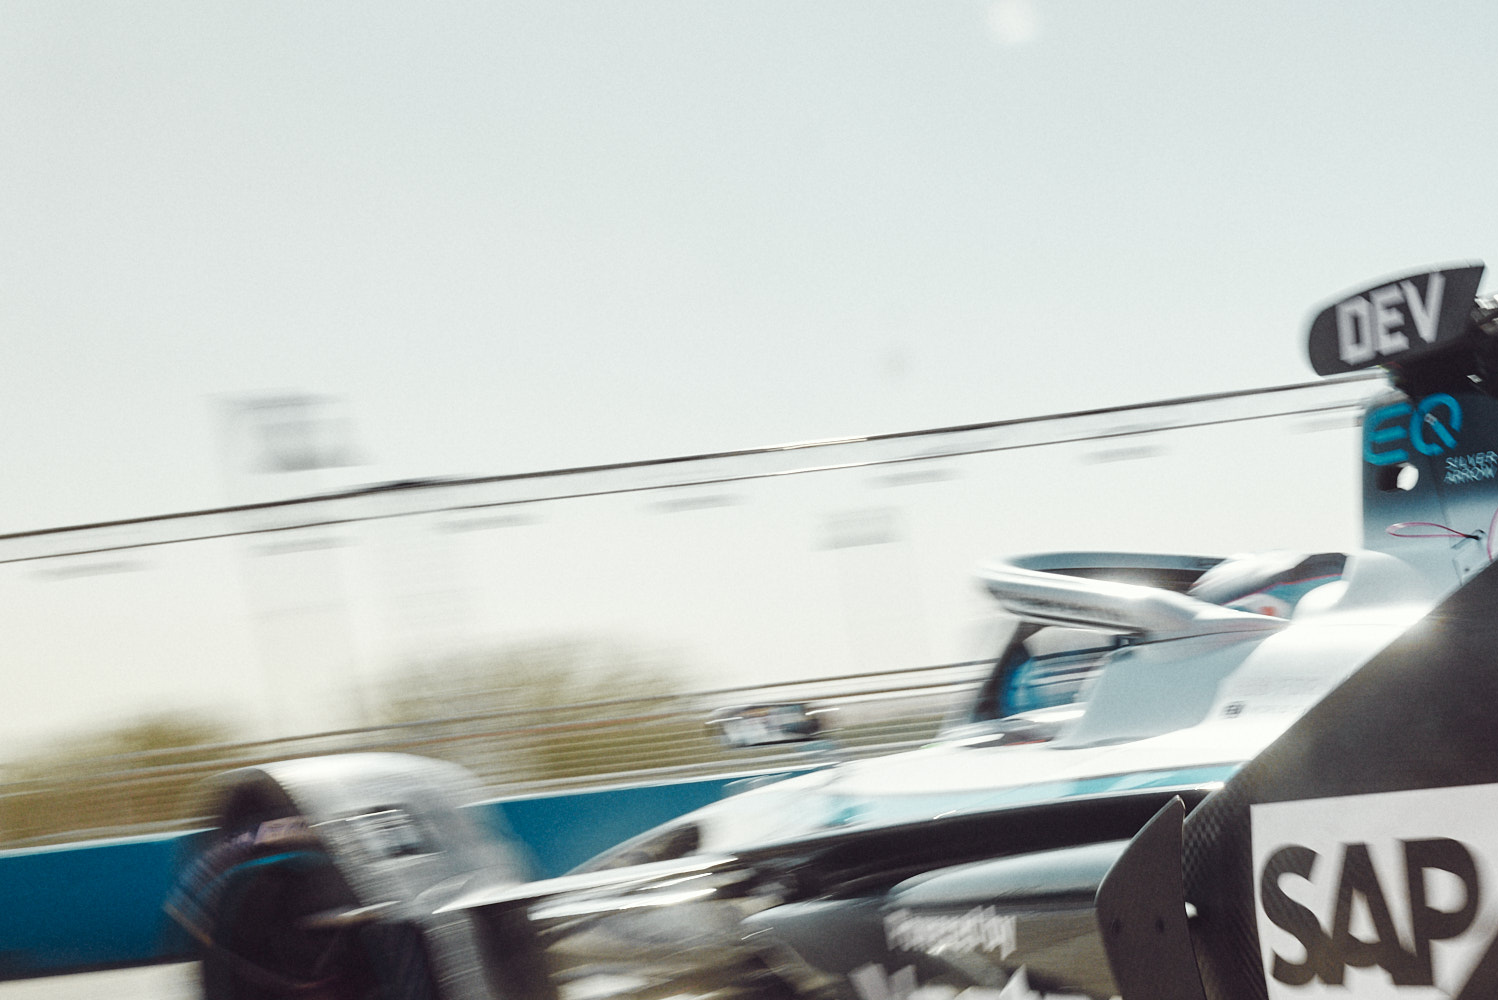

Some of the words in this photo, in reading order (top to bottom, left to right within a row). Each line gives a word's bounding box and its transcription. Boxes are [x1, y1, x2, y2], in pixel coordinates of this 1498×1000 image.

[1336, 272, 1446, 365] DEV
[1363, 393, 1463, 466] EQ
[1260, 836, 1484, 988] SAP
